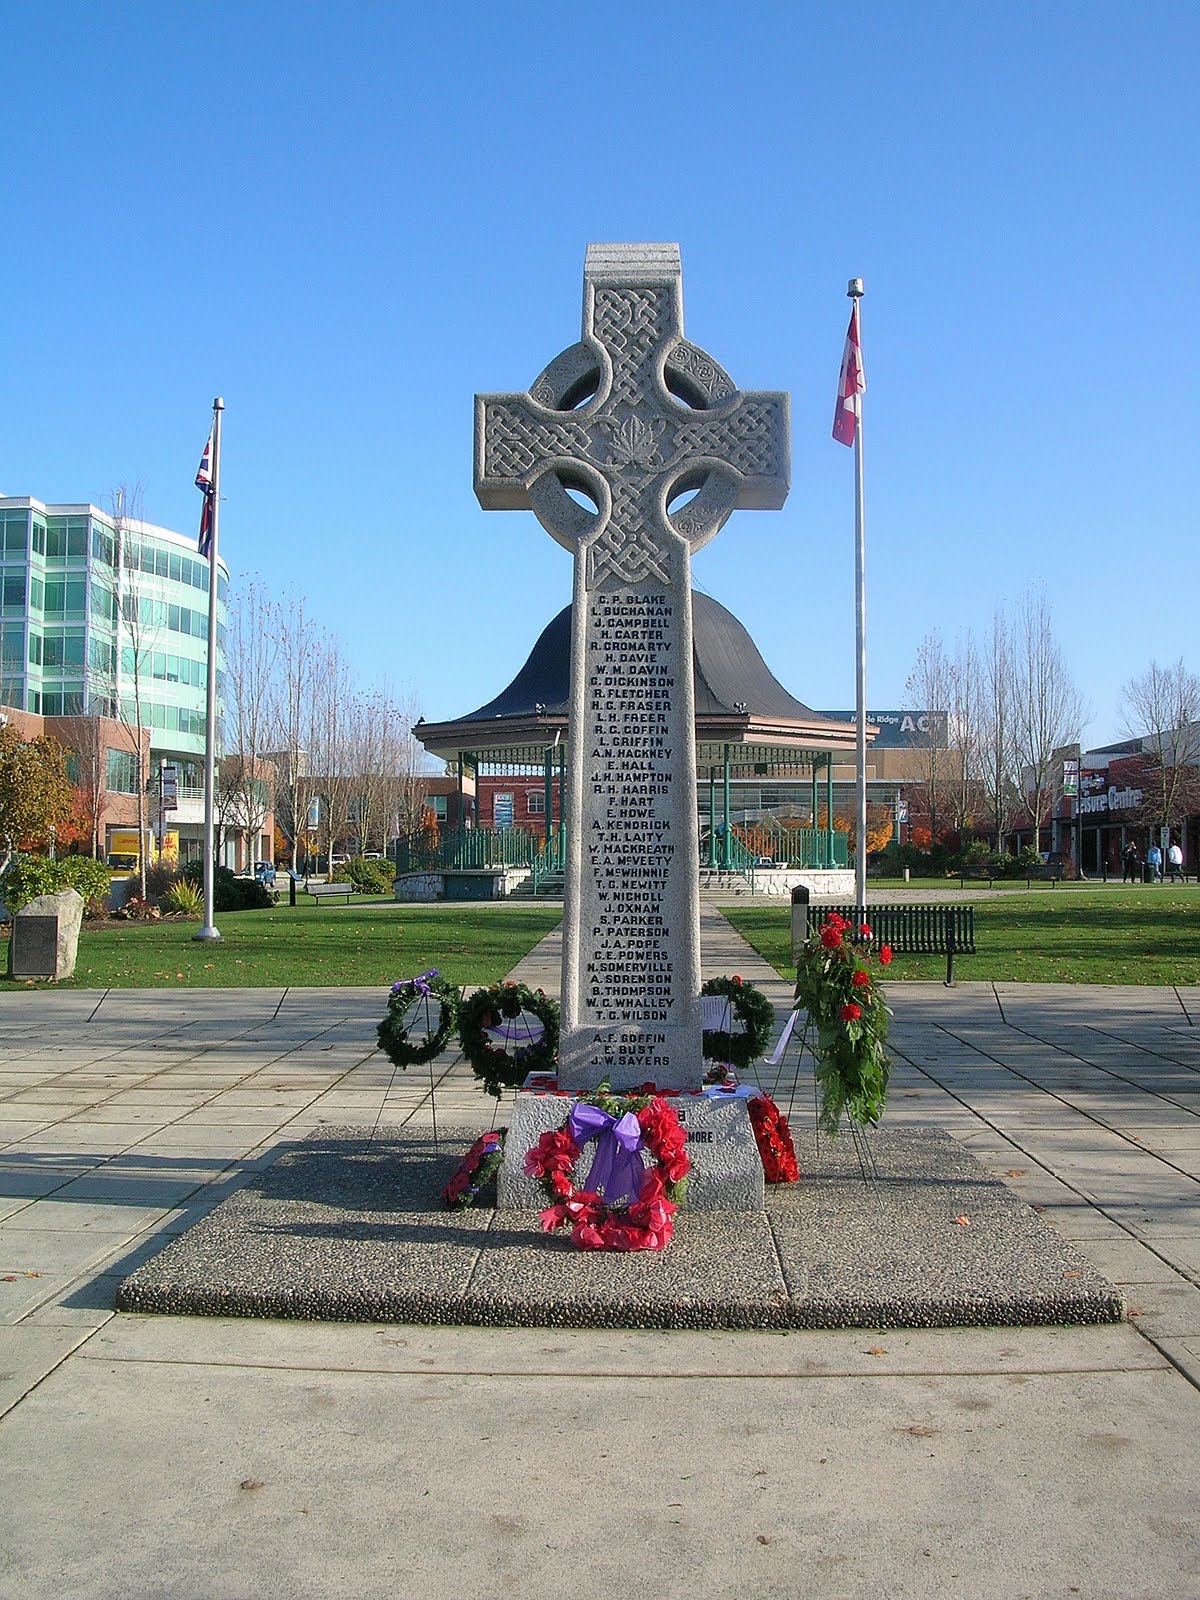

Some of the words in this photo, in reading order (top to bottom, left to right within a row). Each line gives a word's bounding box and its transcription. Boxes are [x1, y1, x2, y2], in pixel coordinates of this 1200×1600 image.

[627, 596, 666, 604] BLAKE
[592, 607, 601, 616] L.
[604, 607, 672, 616] BUCHANAN
[595, 619, 605, 627] J.
[608, 619, 669, 627] CAMPBELL
[601, 631, 611, 639] H.
[616, 631, 663, 639] CARTER
[591, 642, 601, 651] R.
[604, 642, 672, 651] CROMARTY
[606, 654, 616, 662] H.
[620, 654, 657, 662] DAVIE
[630, 665, 668, 674] DAVIN
[605, 677, 674, 686] DICKINSON
[594, 689, 605, 698] R.
[608, 689, 669, 698] FLETCHER
[621, 701, 672, 710] FRASER
[624, 714, 666, 722] FREER
[877, 715, 899, 725] Ridge
[600, 737, 609, 746] L.
[613, 737, 663, 746] GRIFFIN
[618, 749, 672, 758] HACKNEY
[608, 761, 619, 770] E.
[622, 761, 655, 770] HALL
[617, 773, 672, 782] HAMPTON
[623, 785, 669, 794] HARRIS
[610, 797, 618, 806] F.
[622, 797, 654, 806] HART
[607, 809, 616, 817] E.
[621, 809, 655, 817] HOWE
[592, 821, 604, 829] A.
[608, 821, 670, 829] KENDRICK
[625, 833, 663, 841] LAITY
[589, 845, 600, 853] W.
[604, 845, 674, 853] MACKREATH
[594, 868, 603, 877] F.
[622, 880, 667, 889] NEWITT
[599, 893, 610, 901] W.
[614, 893, 663, 901] NICHOLL
[605, 904, 615, 913] J.
[618, 904, 660, 913] OXNAM
[600, 916, 610, 925] S.
[614, 916, 663, 925] PARKER
[593, 928, 604, 936] P.
[608, 928, 669, 936] PATERSON
[628, 940, 660, 948] POPE
[619, 951, 668, 960] POWERS
[587, 963, 598, 972] N.
[601, 963, 673, 972] SOMERVILLE
[591, 975, 603, 983] A.
[606, 975, 671, 983] SORENSON
[593, 987, 604, 995] B.
[605, 987, 671, 995] THOMPSON
[616, 999, 674, 1007] WHALLEY
[622, 1011, 667, 1020] WILSON
[622, 1034, 666, 1043] GOFFIN
[605, 1046, 615, 1054] E.
[620, 1046, 655, 1054] BUST
[619, 1056, 670, 1065] SAYERS
